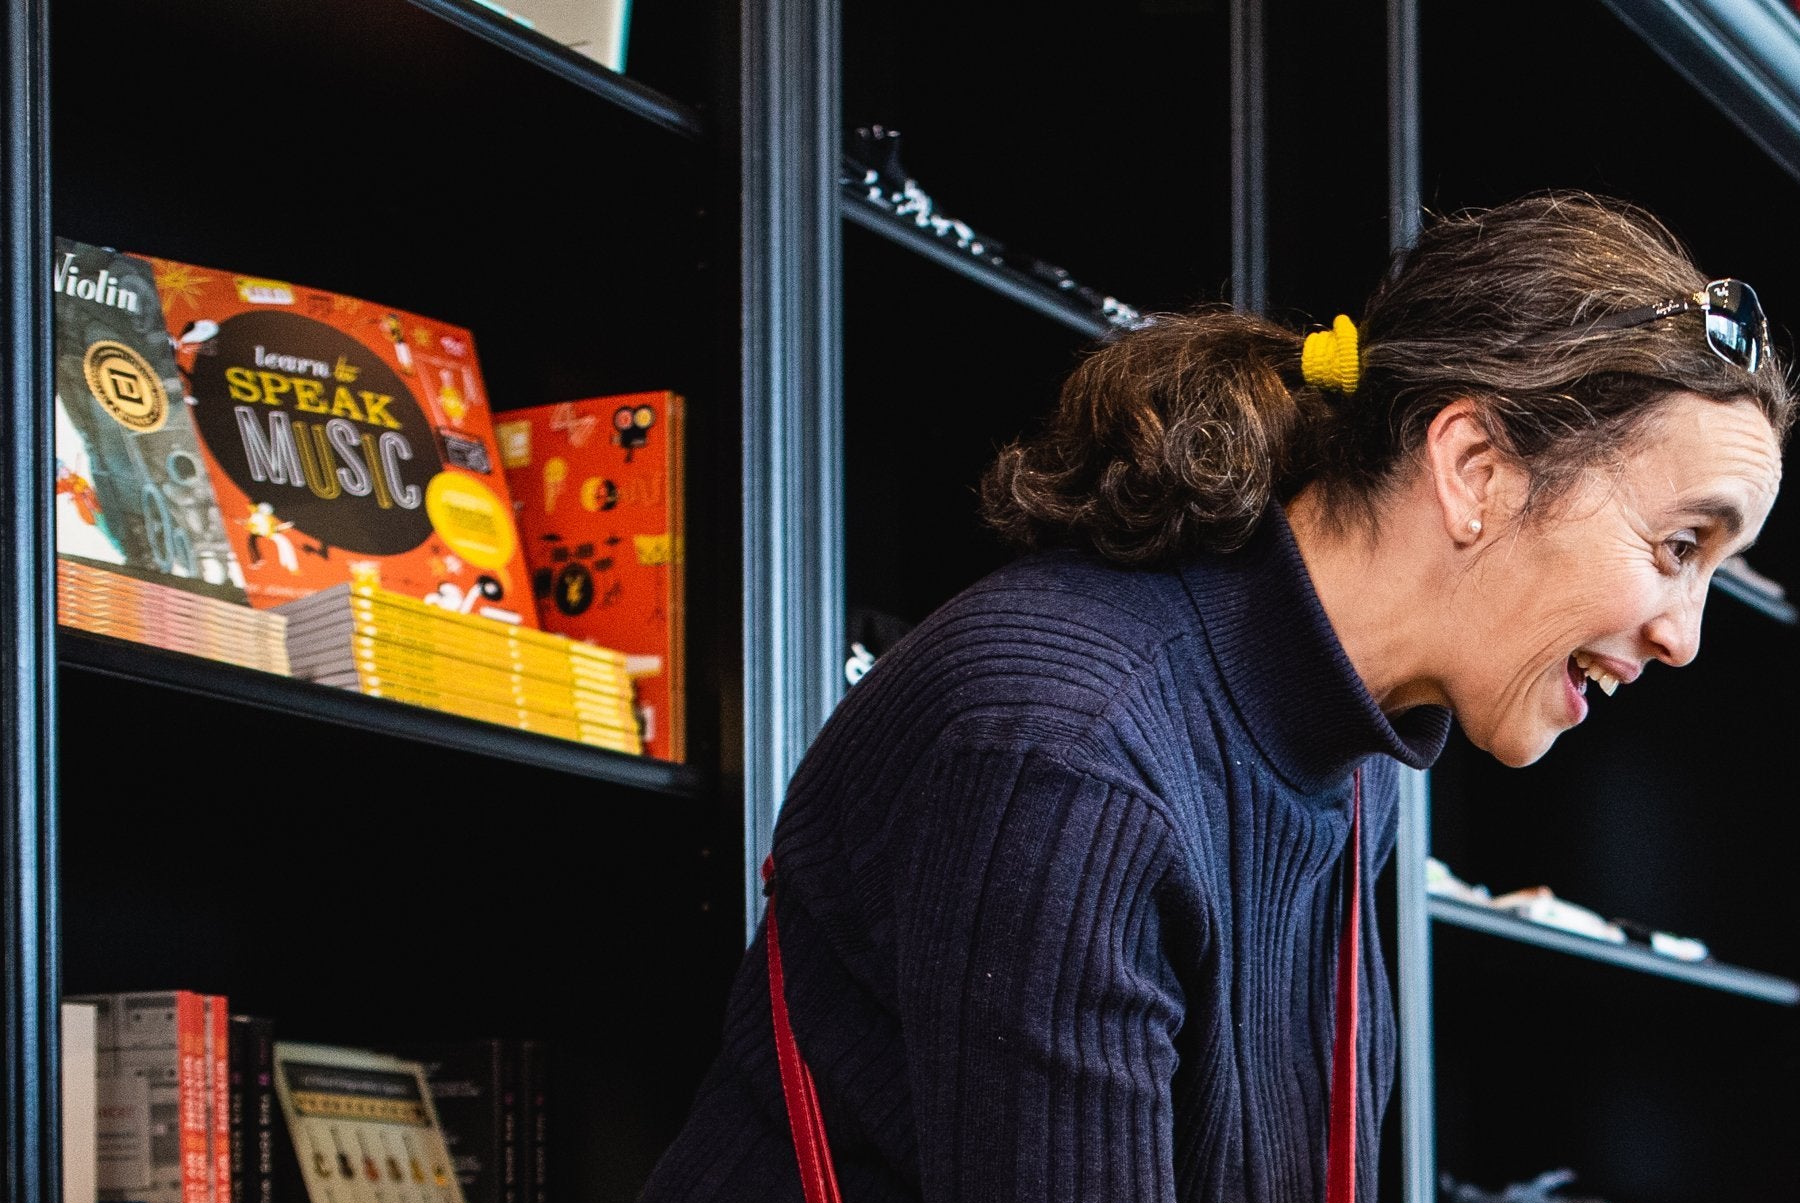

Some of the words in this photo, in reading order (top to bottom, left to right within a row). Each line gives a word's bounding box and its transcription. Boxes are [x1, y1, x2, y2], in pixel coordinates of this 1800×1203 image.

[54, 253, 140, 314] Violin
[255, 344, 330, 378] learn
[225, 366, 402, 430] SPEAK
[234, 405, 422, 509] MUSIC
